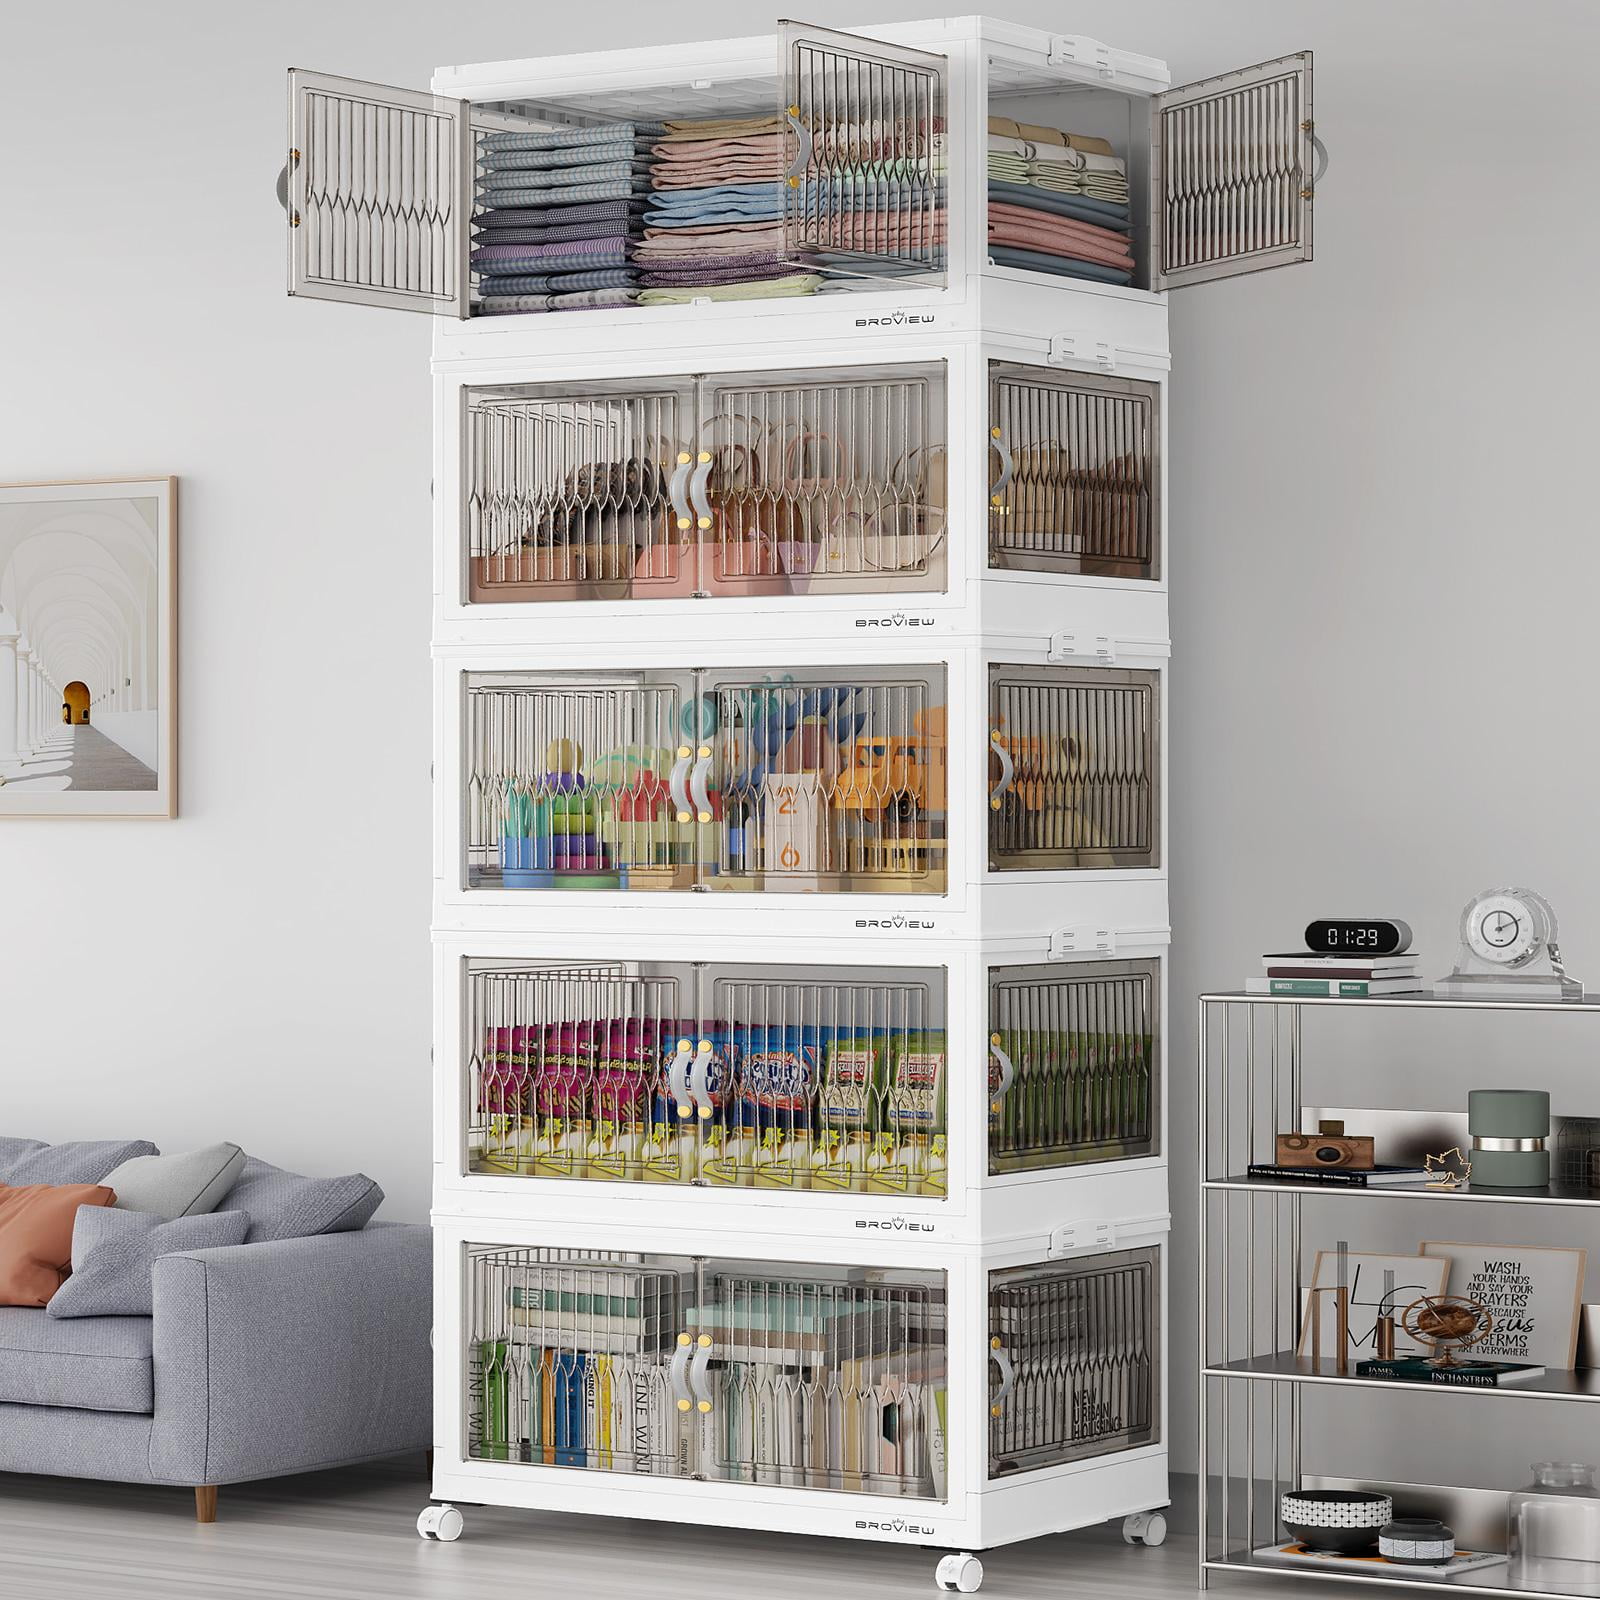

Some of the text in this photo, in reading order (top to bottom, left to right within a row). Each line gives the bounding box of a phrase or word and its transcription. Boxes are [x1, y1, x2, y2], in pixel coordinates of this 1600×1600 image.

[855, 314, 935, 327] BROVIEW
[855, 617, 935, 627] BROVIEW
[855, 918, 935, 929] BROVIEW
[1327, 928, 1378, 946] 01:29
[855, 1219, 935, 1232] BROVIEW
[1483, 1260, 1521, 1275] WASH
[1472, 1273, 1530, 1285] YOUR HANDS
[1466, 1282, 1534, 1295] AND SAY YOUR
[1470, 1292, 1529, 1307] PRAYERS
[1487, 1307, 1527, 1318] BECAUSE
[1480, 1333, 1528, 1348] GERMS
[1477, 1345, 1530, 1357] EVERYWHERE
[1368, 1366, 1394, 1374] JAMES
[1431, 1372, 1494, 1384] ENCHANTRESS
[680, 1438, 688, 1465] GROWN
[855, 1520, 935, 1535] BROVIEW
